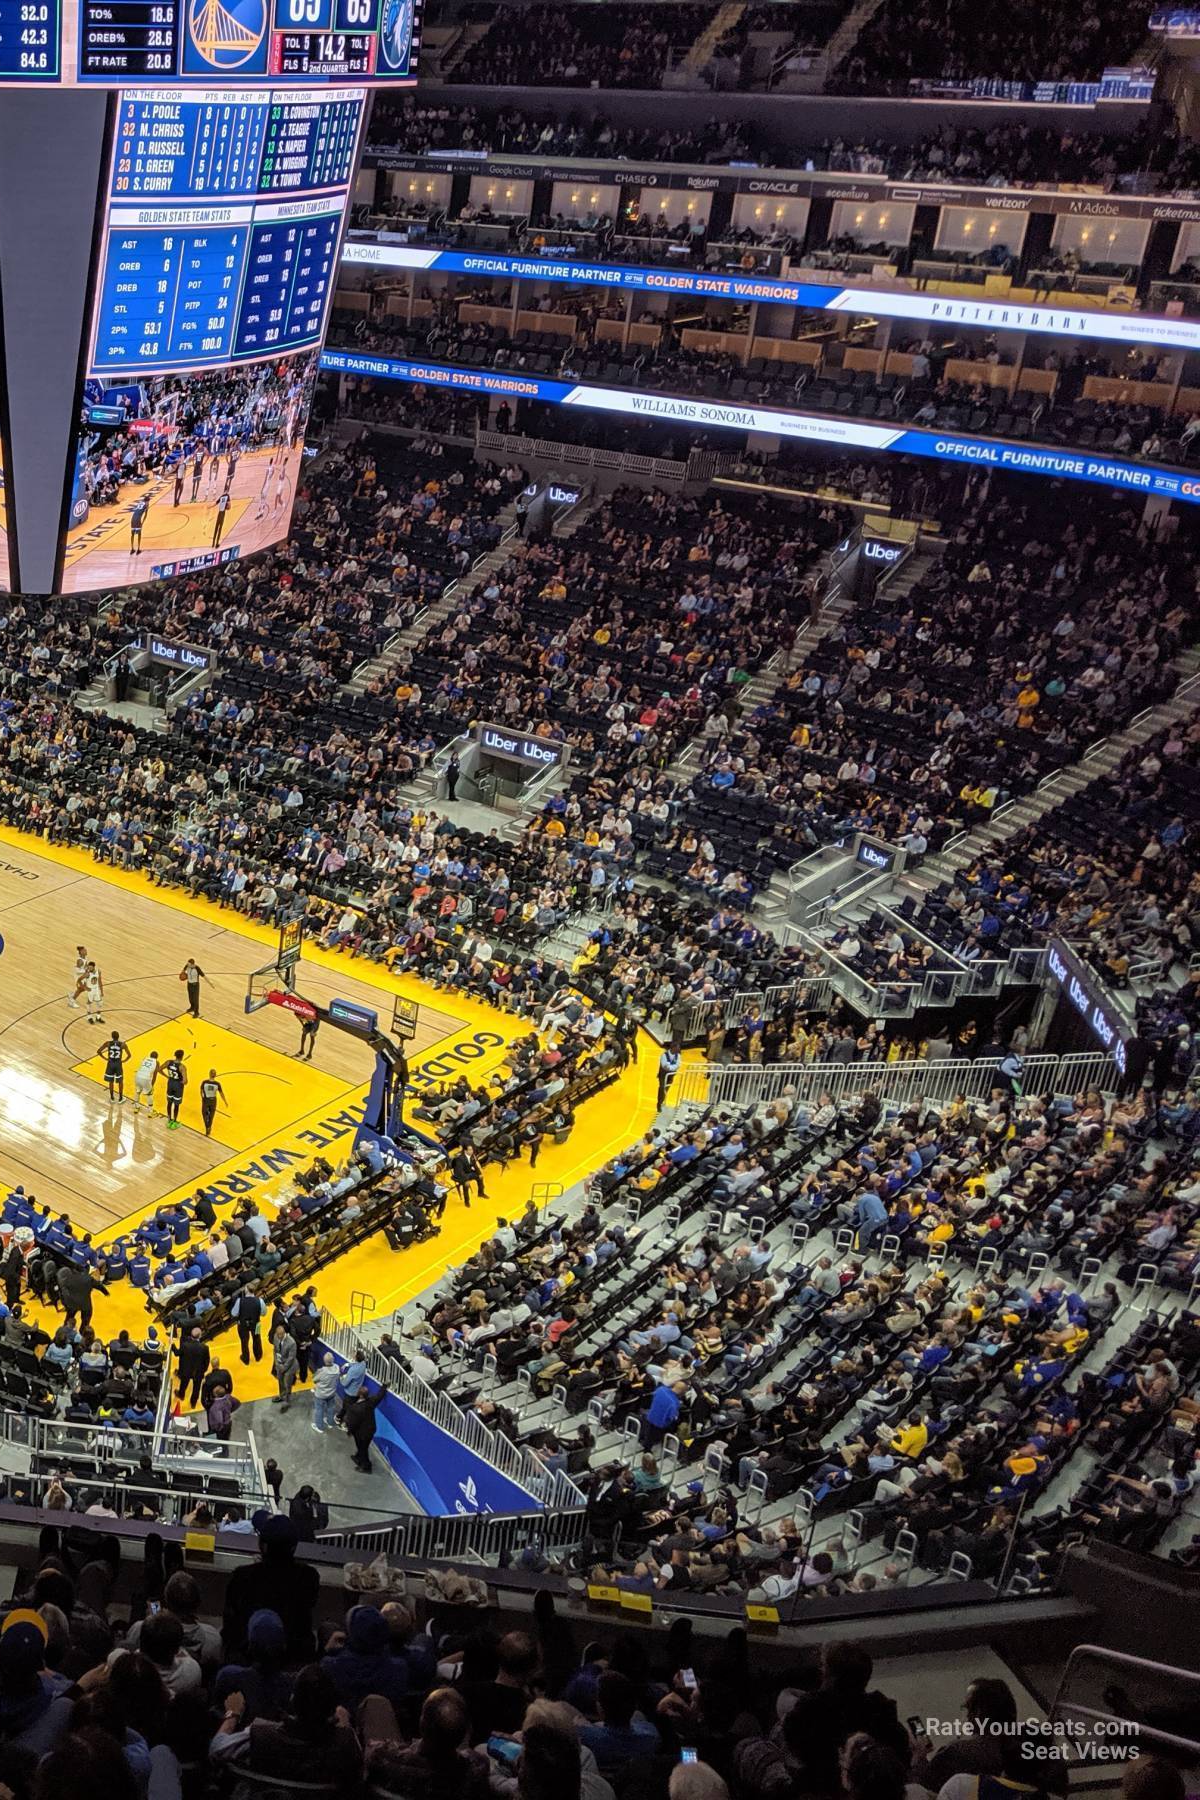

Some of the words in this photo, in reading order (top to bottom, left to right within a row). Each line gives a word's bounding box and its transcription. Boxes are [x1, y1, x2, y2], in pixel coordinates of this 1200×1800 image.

[21, 6, 47, 20] 32.0
[89, 10, 112, 19] TO%
[151, 7, 173, 22] 18.6
[21, 29, 47, 44] 42.3
[89, 33, 125, 43] OREB%
[148, 31, 172, 46] 28.6
[318, 36, 345, 60] 14.2
[20, 53, 47, 68] 84.6
[88, 57, 99, 65] FT
[102, 57, 127, 66] RATE
[147, 54, 171, 69] 20.8
[309, 65, 321, 73] 2nd
[322, 65, 348, 73] QUARTER
[126, 91, 138, 99] ON
[140, 92, 155, 100] THE
[157, 92, 182, 100] FLOOR
[142, 105, 150, 118] J.
[152, 106, 181, 119] POOLE
[123, 123, 135, 136] 32
[140, 124, 150, 137] M.
[152, 124, 185, 137] CHRISS
[138, 142, 146, 155] D.
[148, 142, 185, 155] RUSSELL
[118, 159, 131, 172] 23
[135, 160, 144, 172] D.
[146, 160, 174, 173] GREEN
[489, 165, 512, 176] Google
[514, 168, 532, 176] Cloud
[116, 177, 128, 190] 30
[134, 178, 142, 190] S.
[144, 178, 173, 190] CURRY
[615, 174, 647, 184] CHASE
[687, 177, 719, 188] Rakuten
[749, 182, 798, 193] ORACLE
[986, 197, 1025, 209] verizon
[1084, 203, 1120, 214] Adobe
[139, 211, 167, 222] GOLDEN
[169, 211, 190, 222] STATE
[191, 210, 209, 221] TEAM
[211, 210, 231, 221] STATS
[122, 241, 137, 249] AST
[354, 250, 381, 259] HOME
[119, 262, 140, 271] OREB
[464, 258, 508, 272] OFFICIAL
[511, 262, 568, 277] FURNITURE
[572, 267, 620, 282] PARTNER
[646, 276, 693, 289] GOLDEN
[696, 280, 730, 293] STATE
[734, 284, 799, 300] WARRIORS
[117, 284, 138, 292] DREB
[188, 281, 201, 289] POT
[114, 305, 128, 313] STL
[111, 326, 128, 334] 2P%
[144, 322, 162, 335] 53.1
[182, 322, 197, 330] FG%
[208, 317, 225, 330] 50.0
[108, 347, 125, 355] 3P%
[139, 342, 158, 355] 43.8
[202, 337, 221, 350] 100.0
[347, 358, 389, 373] PARTNER
[410, 368, 450, 381] GOLDEN
[452, 374, 481, 386] STATE
[484, 378, 539, 394] WARRIORS
[632, 398, 696, 416] WILLIAMS
[700, 408, 756, 425] SONOMA
[936, 442, 998, 461] OFFICIAL
[1002, 451, 1084, 473] FURNITURE
[1088, 463, 1151, 486] PARTNER
[1165, 481, 1177, 489] THE
[550, 487, 579, 503] Uber
[865, 542, 901, 561] Uber
[152, 642, 177, 659] Uber
[181, 649, 207, 668] Uber
[485, 731, 518, 752] Uber
[524, 742, 557, 762] Uber
[863, 848, 889, 867] Uber
[1049, 948, 1068, 982] Uber
[1070, 976, 1089, 1013] Uber
[1093, 1007, 1114, 1044] Uber
[404, 1032, 504, 1091] GOLDE
